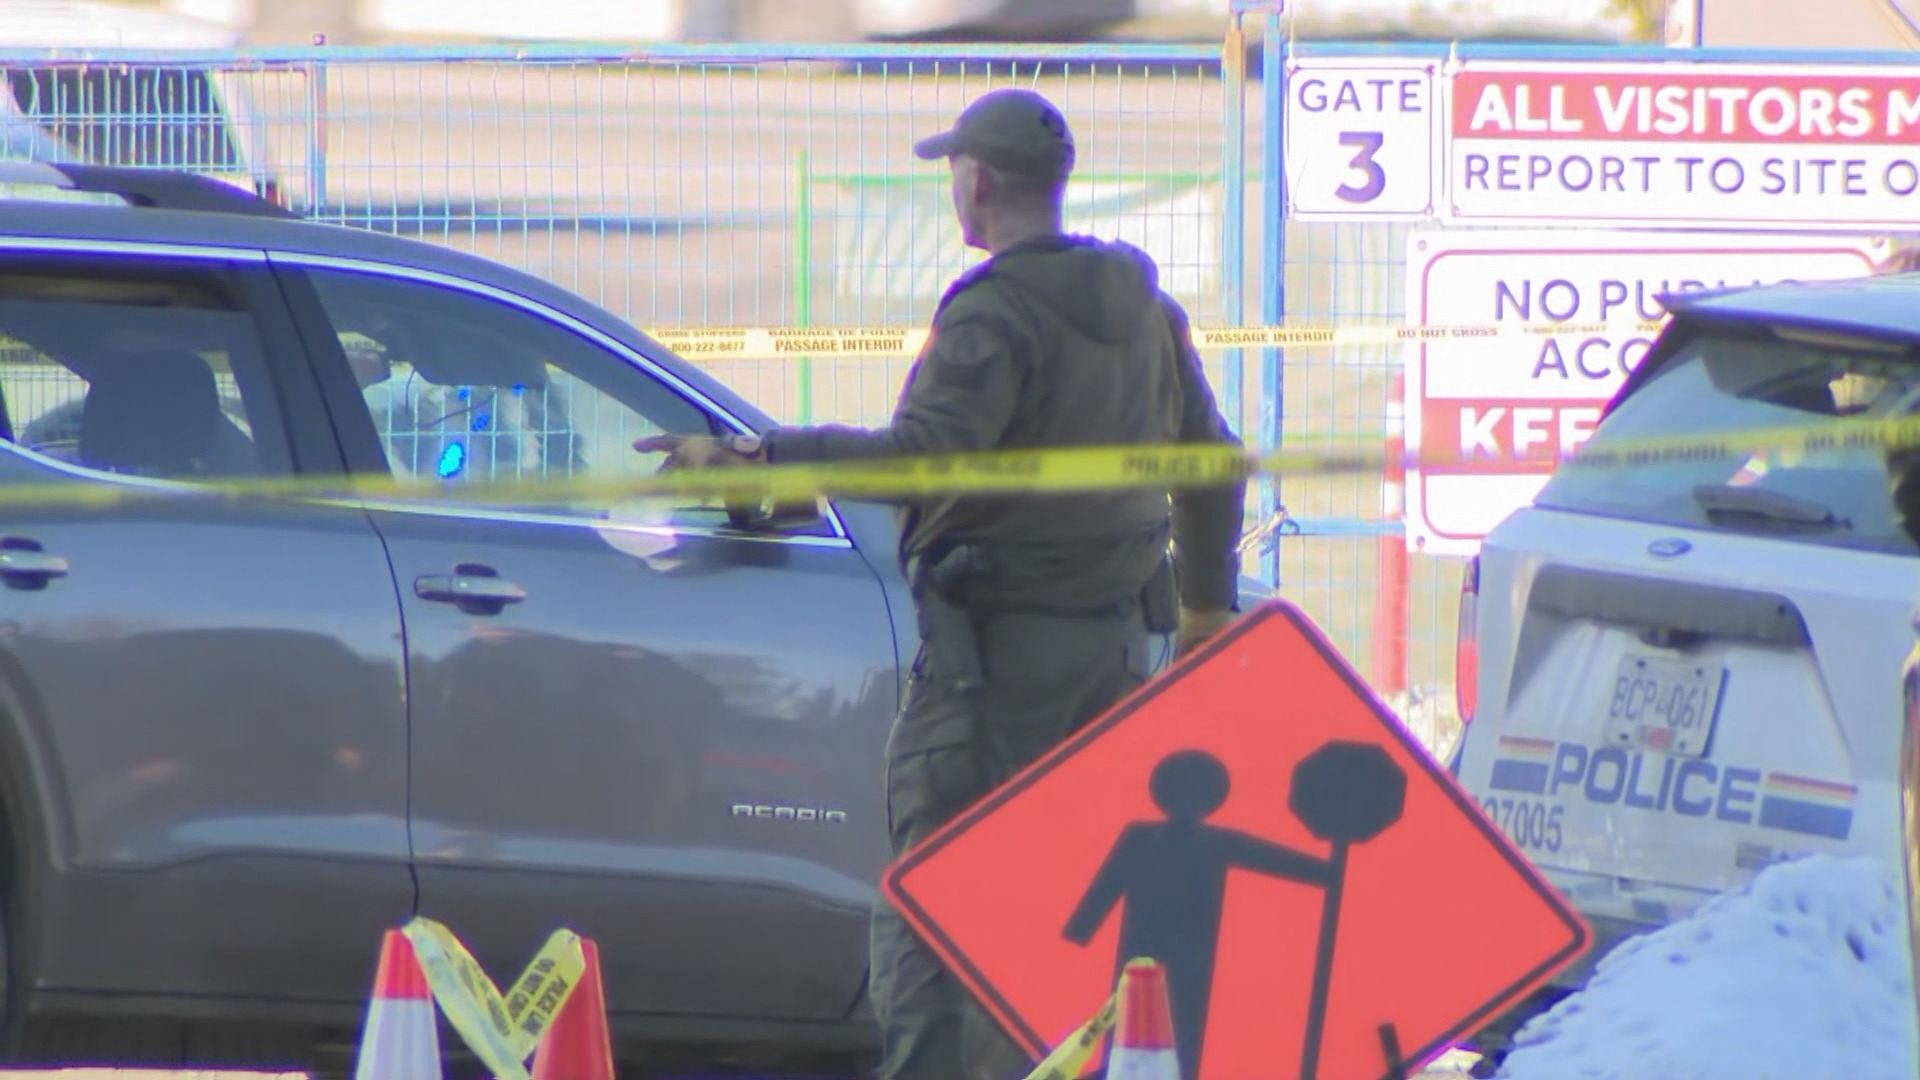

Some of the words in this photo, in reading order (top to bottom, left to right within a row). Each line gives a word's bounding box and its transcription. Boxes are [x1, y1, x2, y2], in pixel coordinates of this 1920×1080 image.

[1298, 78, 1422, 113] GATE
[1470, 84, 1583, 131] ALL
[1594, 86, 1873, 136] VISITORS
[1886, 89, 1920, 136] M
[1334, 131, 1386, 204] 3
[1465, 154, 1660, 194] REPORT
[1675, 157, 1745, 195] TO
[1761, 158, 1867, 196] SITE
[1882, 158, 1919, 197] O
[1495, 279, 1581, 322] NO
[775, 340, 838, 352] PASSAGE
[843, 339, 904, 350] INTERDIT
[1205, 332, 1267, 343] PASSAGE
[1273, 331, 1334, 341] INTERDIT
[1397, 328, 1417, 338] DO
[1421, 328, 1447, 338] NOT
[1452, 327, 1498, 337] CROSS
[1550, 742, 1762, 823] POLICE
[731, 804, 848, 823] ACADIA
